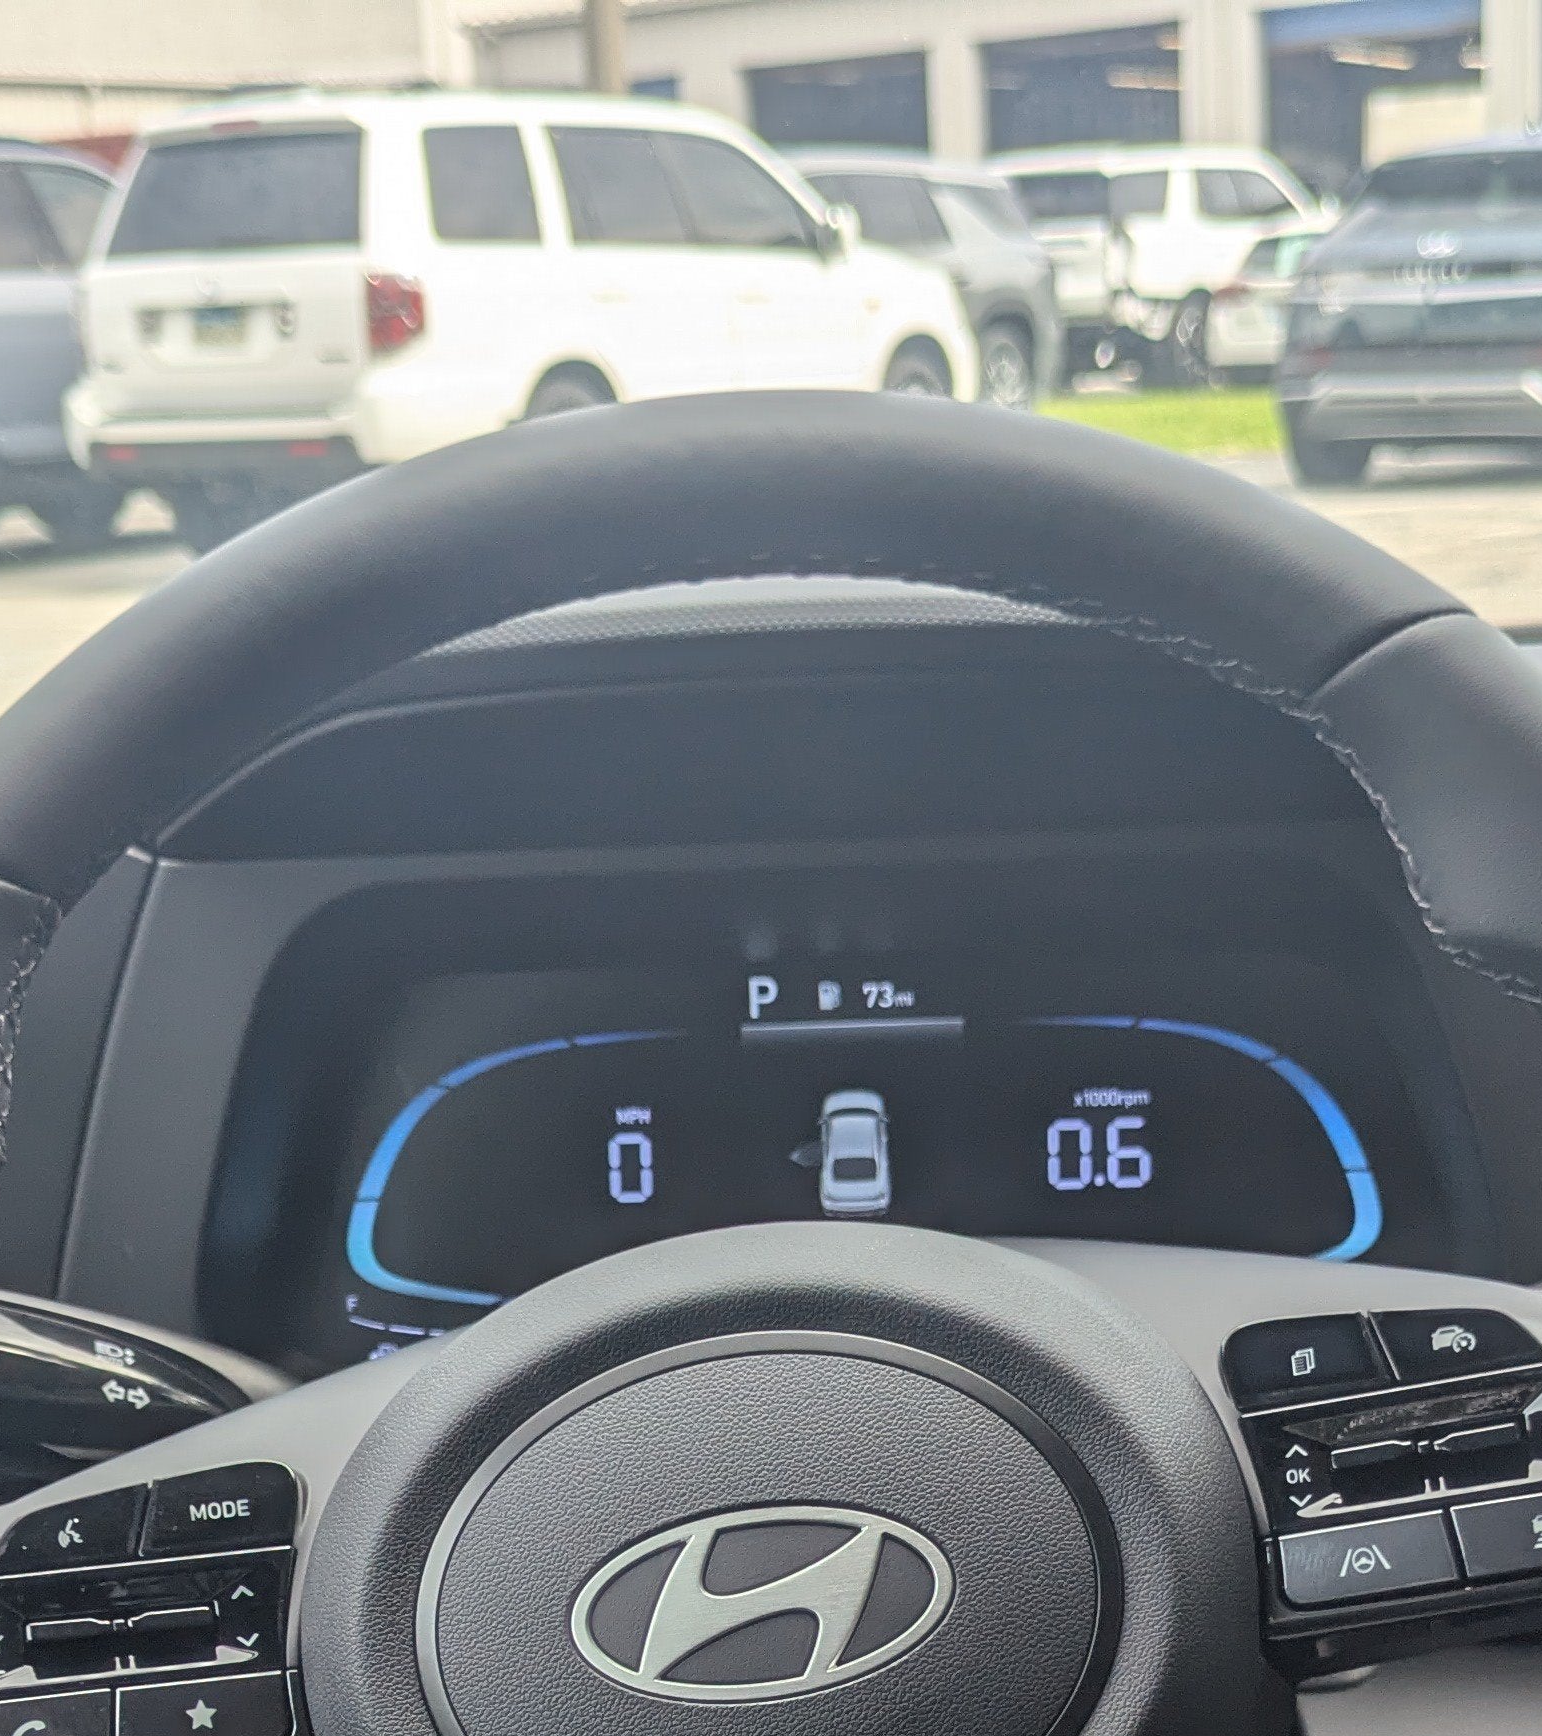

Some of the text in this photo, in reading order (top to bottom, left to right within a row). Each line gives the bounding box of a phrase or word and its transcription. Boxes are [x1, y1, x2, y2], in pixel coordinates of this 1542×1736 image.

[748, 975, 779, 1019] P
[608, 1132, 654, 1204] 0
[1047, 1116, 1152, 1190] 0.6
[1286, 1468, 1311, 1484] OK
[190, 1499, 251, 1522] MODE
